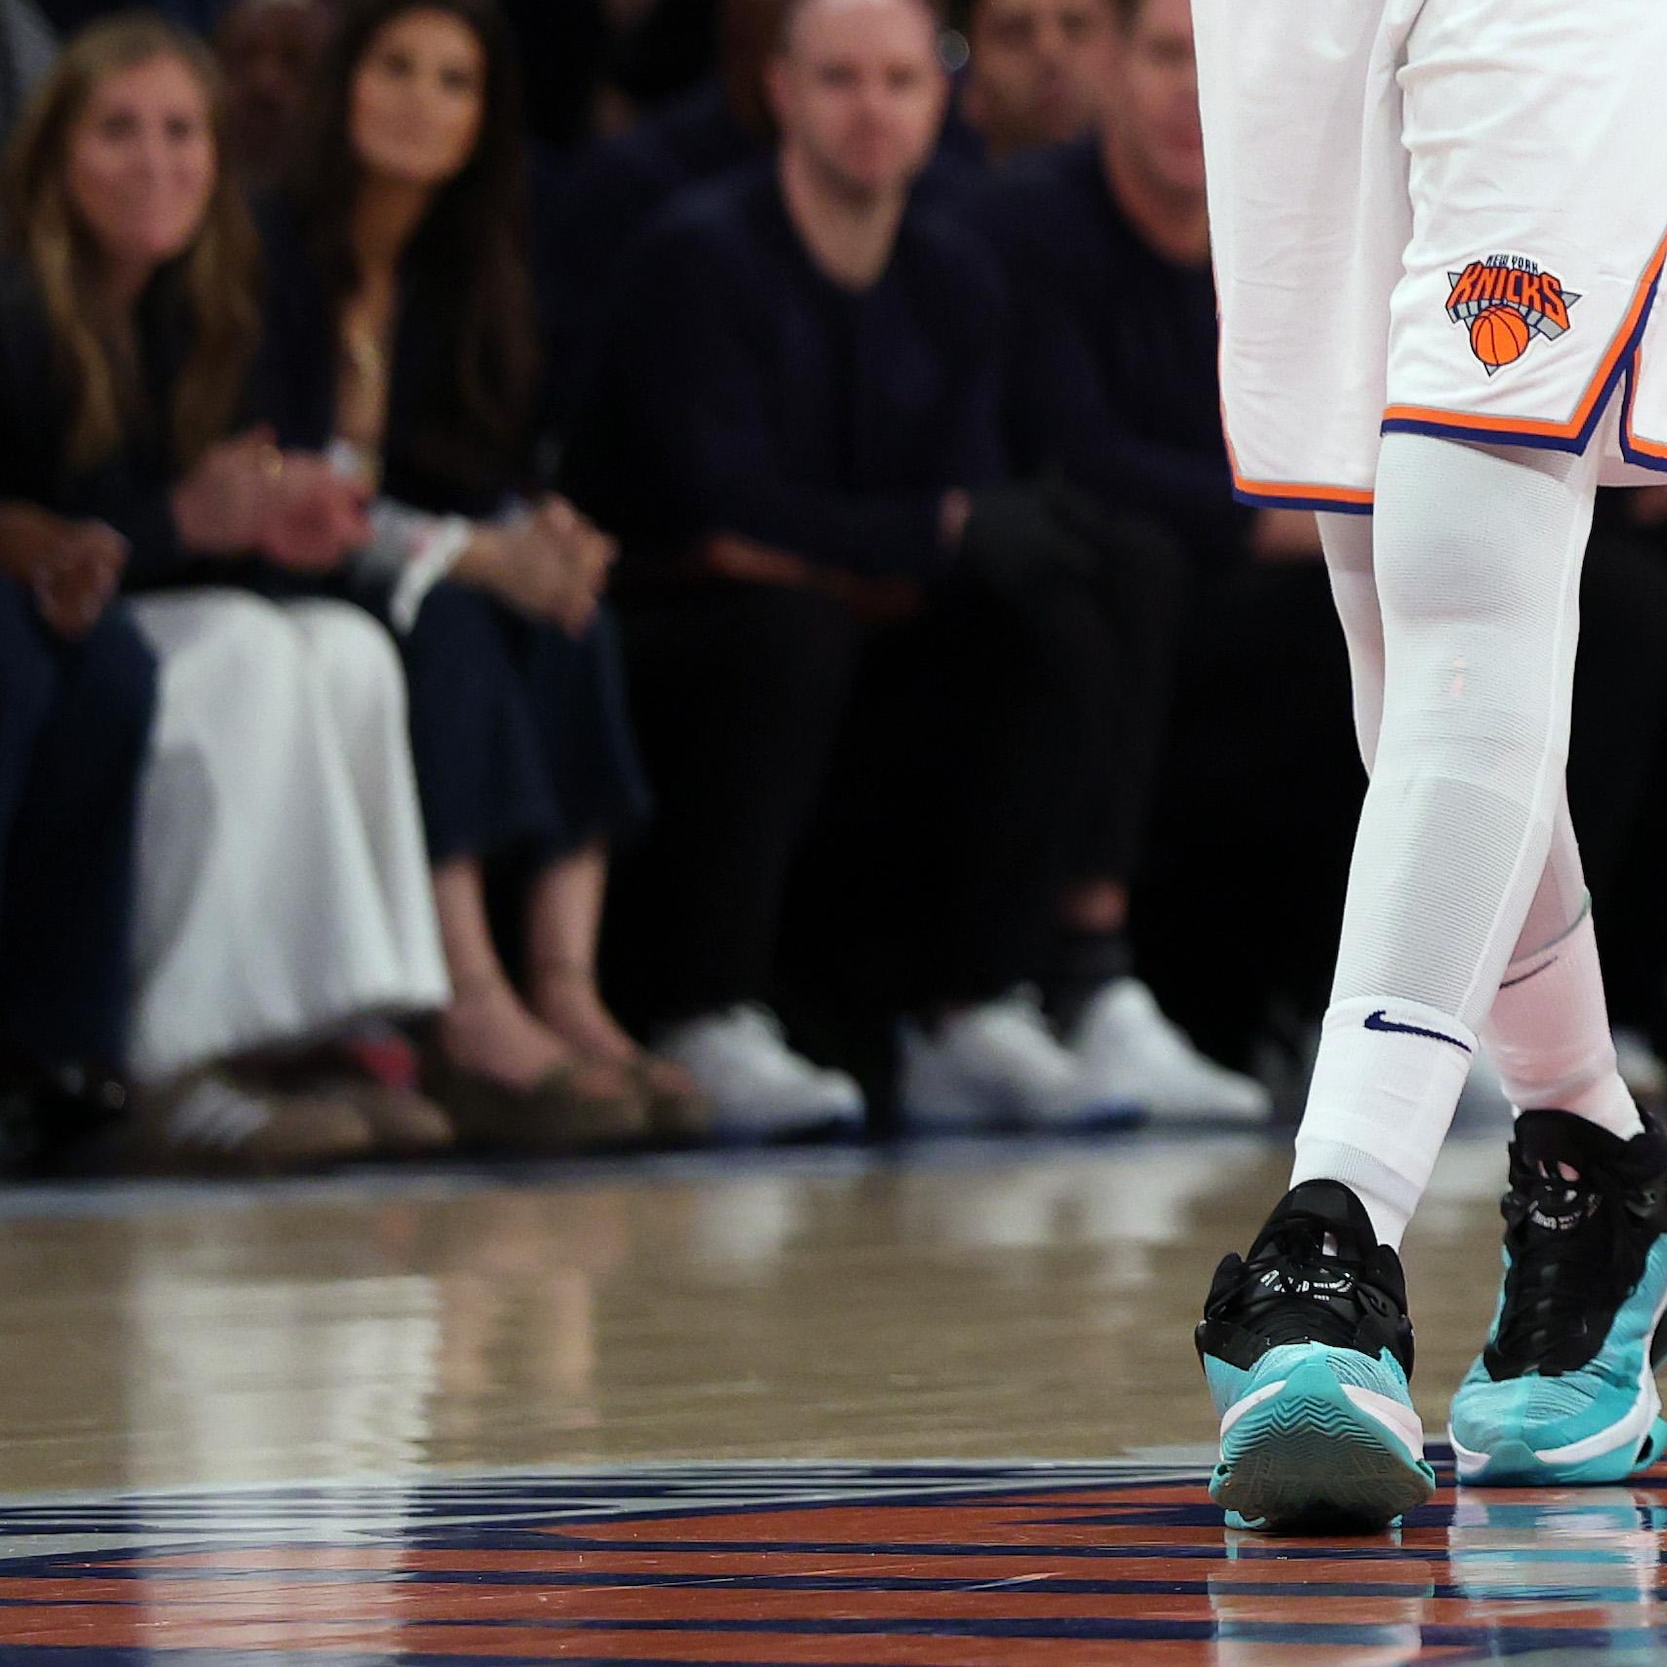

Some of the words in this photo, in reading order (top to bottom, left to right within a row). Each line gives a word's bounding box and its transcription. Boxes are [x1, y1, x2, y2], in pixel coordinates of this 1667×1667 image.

[1486, 253, 1510, 268] NEW
[1511, 254, 1539, 273] YORK
[1445, 260, 1571, 332] KNICKS
